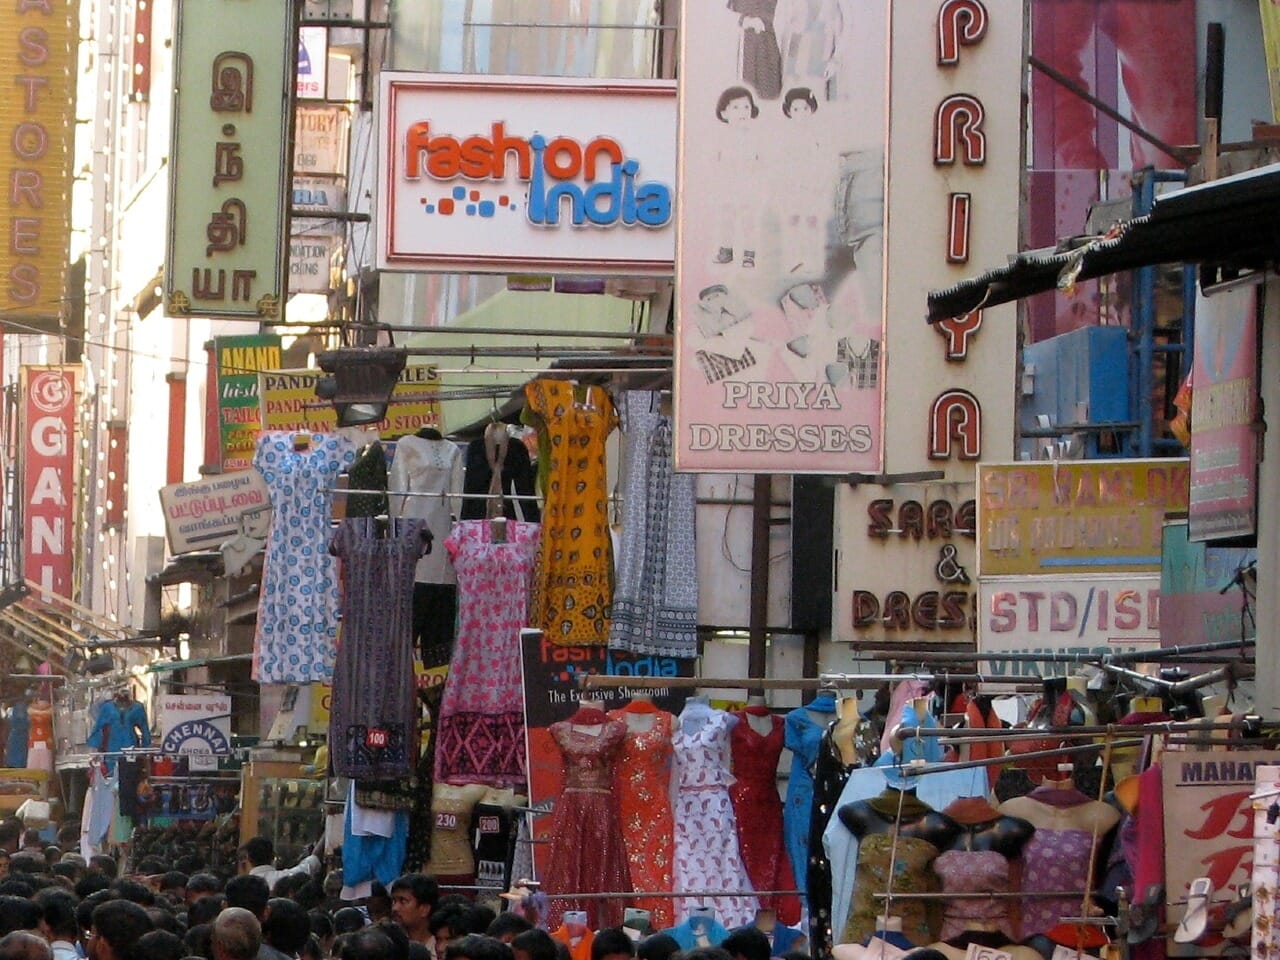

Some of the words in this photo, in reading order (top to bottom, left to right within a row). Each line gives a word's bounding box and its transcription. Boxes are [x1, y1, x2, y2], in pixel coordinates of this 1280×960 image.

[9, 27, 49, 305] STORES
[405, 121, 624, 182] fashion
[928, 0, 988, 461] PRIYA
[221, 345, 281, 375] ANAND
[722, 381, 841, 410] PRIYA
[689, 424, 872, 453] DRESSES
[29, 416, 68, 605] GANI
[935, 543, 972, 584] &
[852, 590, 977, 630] DRES
[548, 689, 567, 704] The
[569, 686, 615, 703] Excusive
[617, 685, 670, 700] Showroom
[164, 723, 227, 753] CHENNAI
[369, 732, 385, 745] 100
[436, 813, 457, 828] 230
